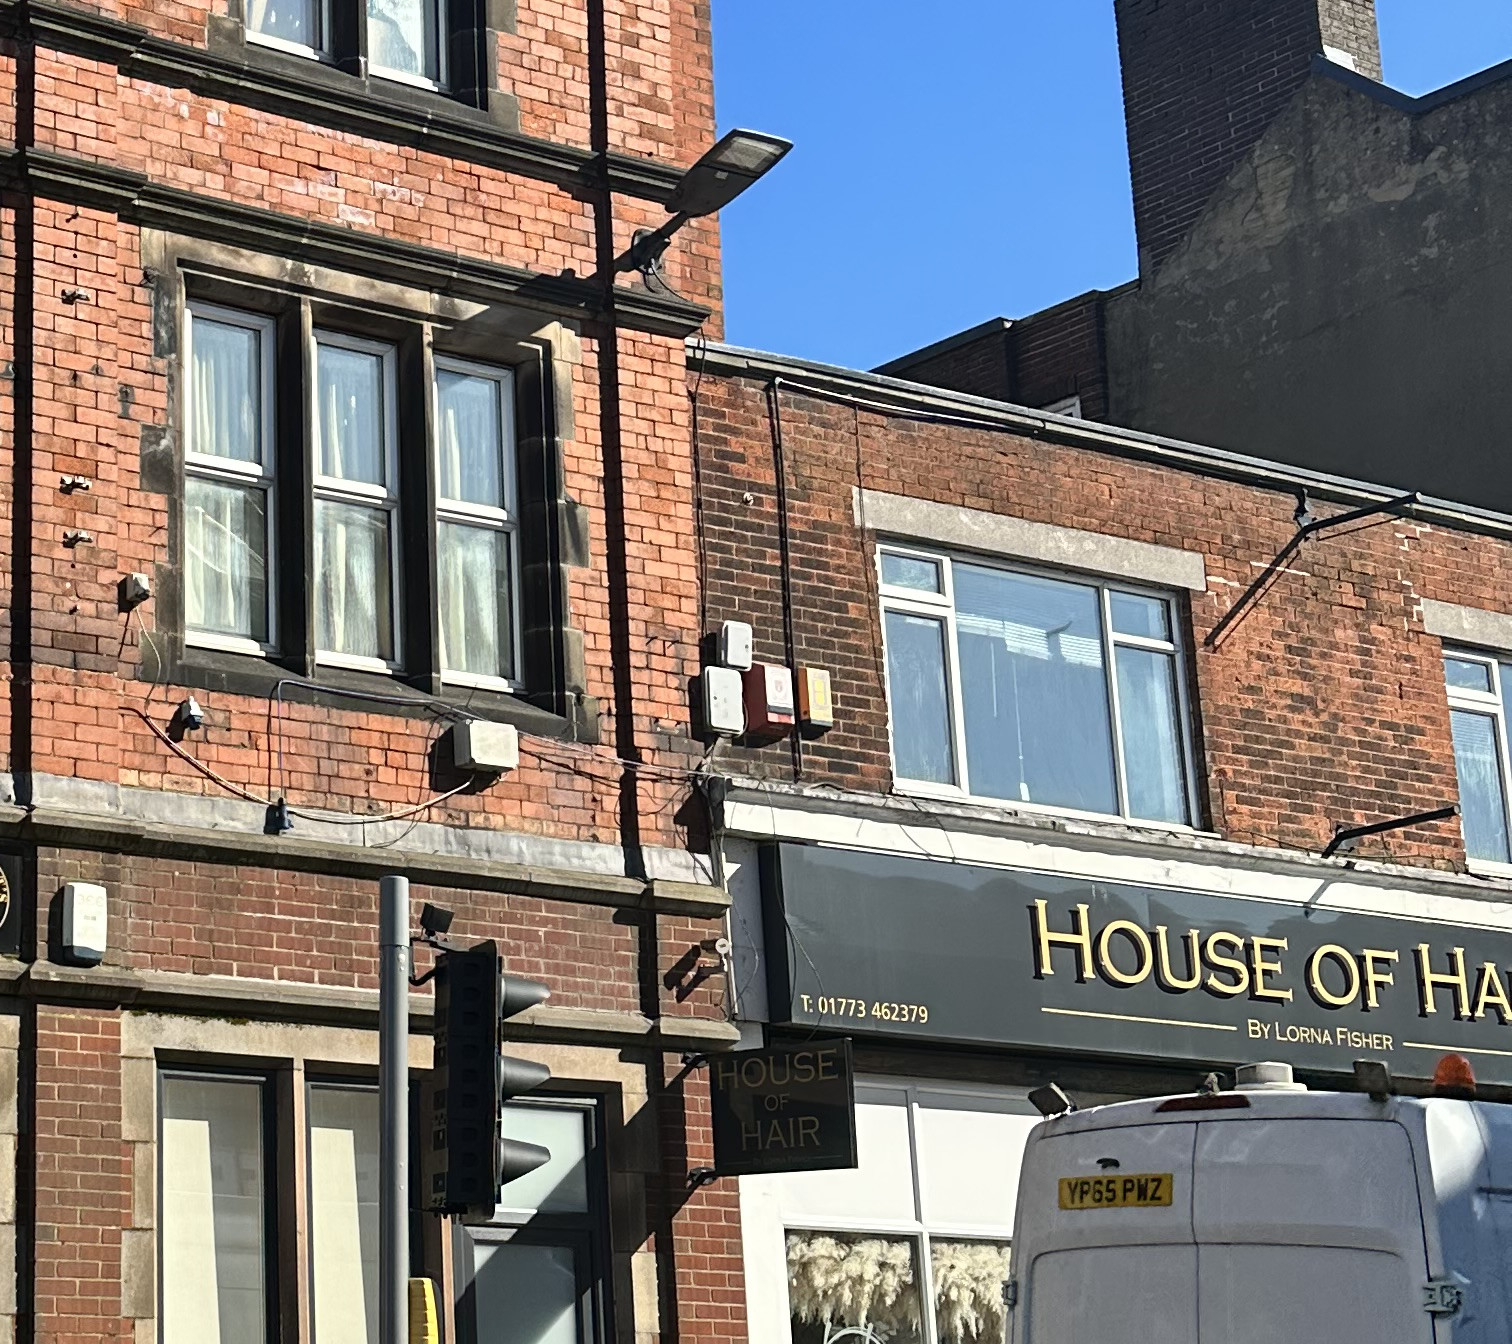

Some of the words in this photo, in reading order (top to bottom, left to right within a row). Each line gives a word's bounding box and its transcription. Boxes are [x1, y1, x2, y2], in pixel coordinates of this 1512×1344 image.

[1031, 898, 1293, 1004] HOUSE
[1309, 943, 1400, 1010] OF
[800, 994, 814, 1013] T:
[817, 996, 866, 1018] 01773
[871, 1001, 929, 1024] 462379
[717, 1048, 839, 1090] HOUSE
[764, 1093, 790, 1112] OF
[741, 1115, 821, 1152] HAIR
[1067, 1179, 1117, 1205] YP65
[1122, 1177, 1163, 1203] PWZ
